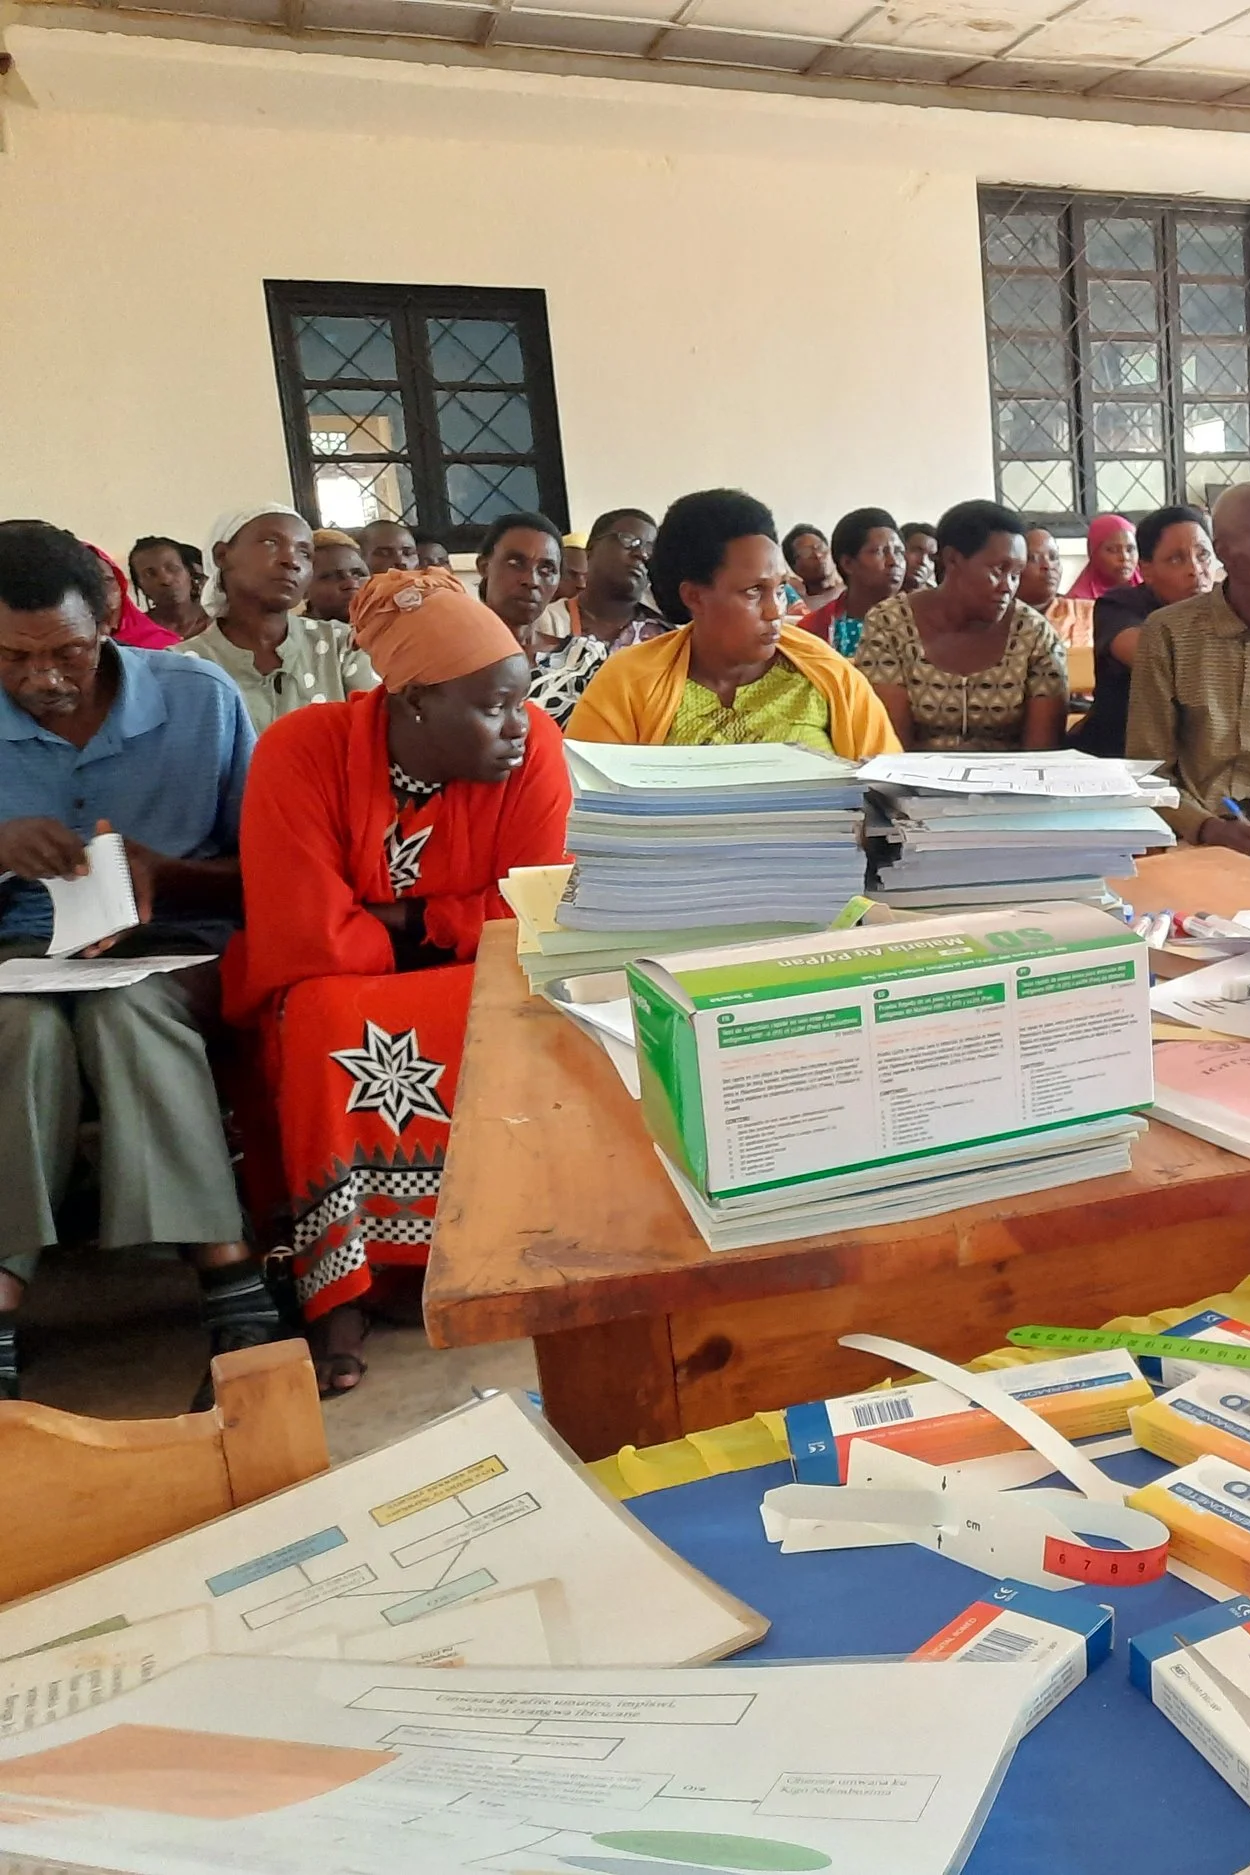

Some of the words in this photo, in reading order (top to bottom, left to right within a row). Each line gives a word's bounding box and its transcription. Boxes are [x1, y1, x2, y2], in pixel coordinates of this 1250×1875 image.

[897, 936, 965, 954] Malaria
[985, 927, 1054, 948] SD
[859, 945, 890, 959] Ag
[966, 1518, 981, 1532] cm
[1058, 1553, 1066, 1565] 6
[1083, 1559, 1091, 1571] 7
[1110, 1563, 1119, 1575] 8
[1137, 1561, 1145, 1574] 9
[994, 1586, 1014, 1599] CE
